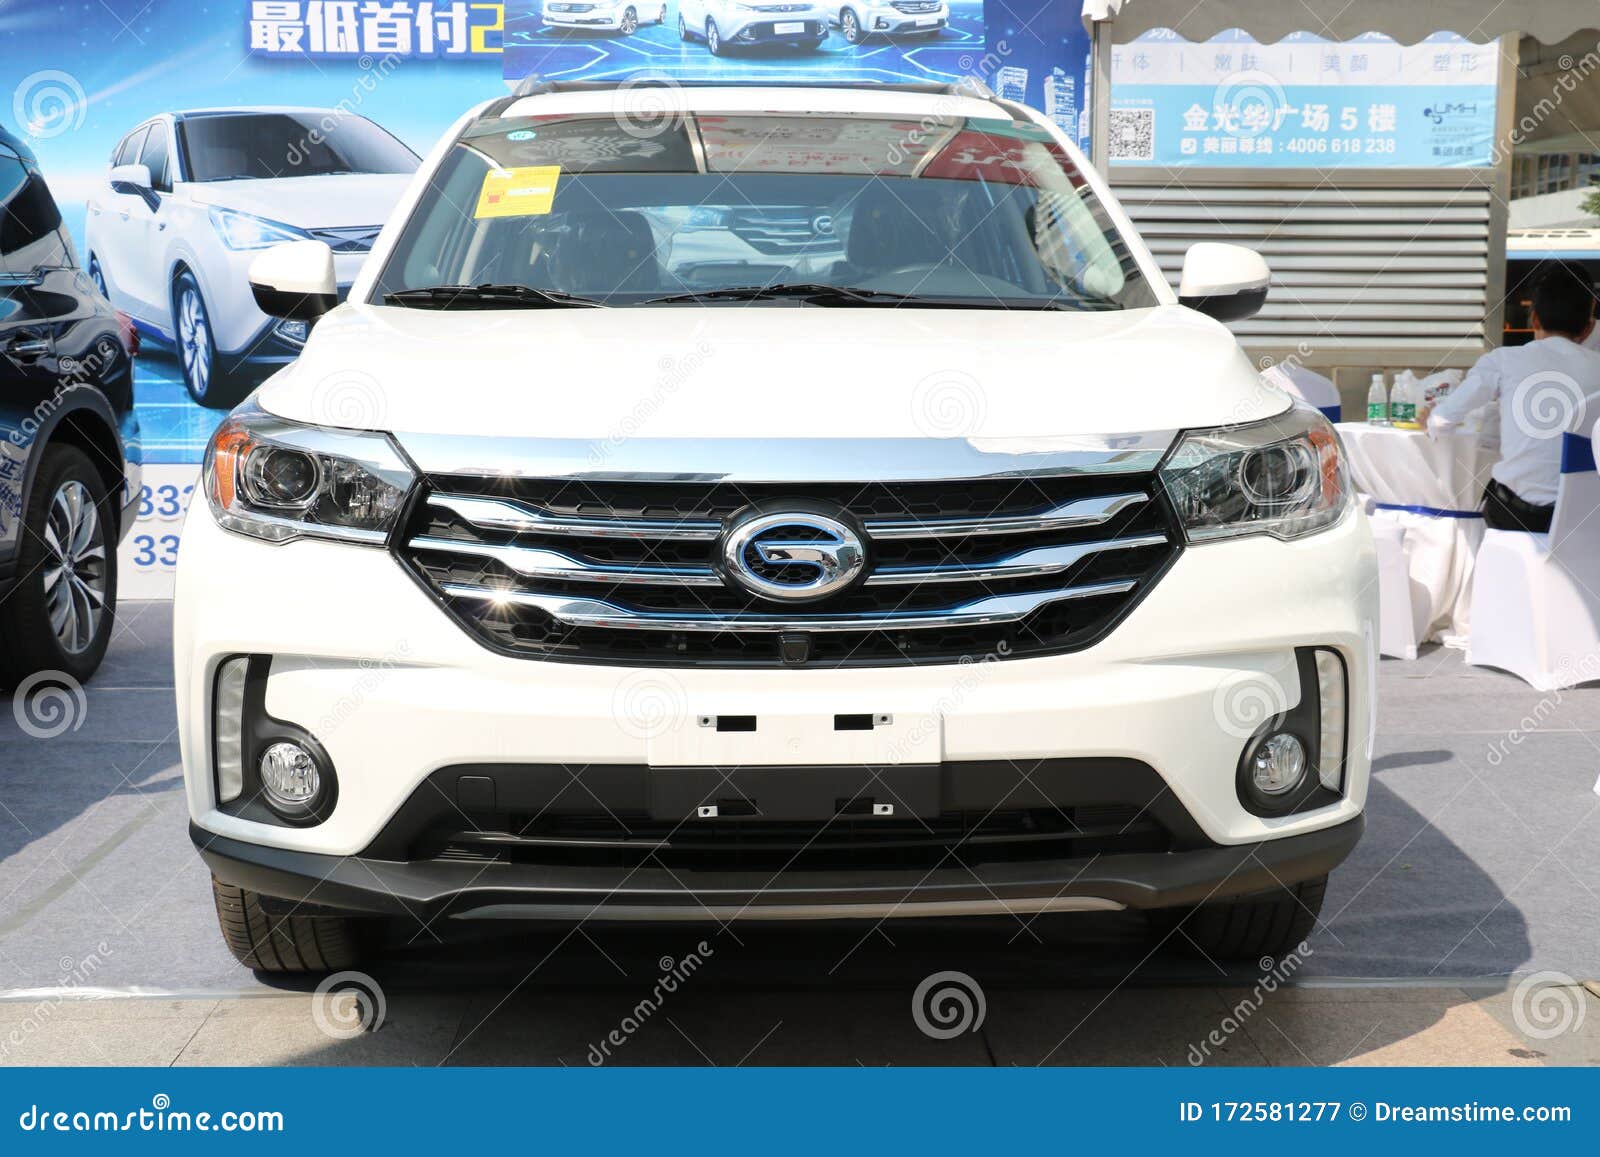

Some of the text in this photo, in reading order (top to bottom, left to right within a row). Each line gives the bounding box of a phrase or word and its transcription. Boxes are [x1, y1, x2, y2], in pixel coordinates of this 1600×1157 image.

[1182, 102, 1331, 132] 金光华广场
[1340, 106, 1359, 131] 5
[1331, 138, 1361, 153] 618
[1365, 138, 1396, 153] 238
